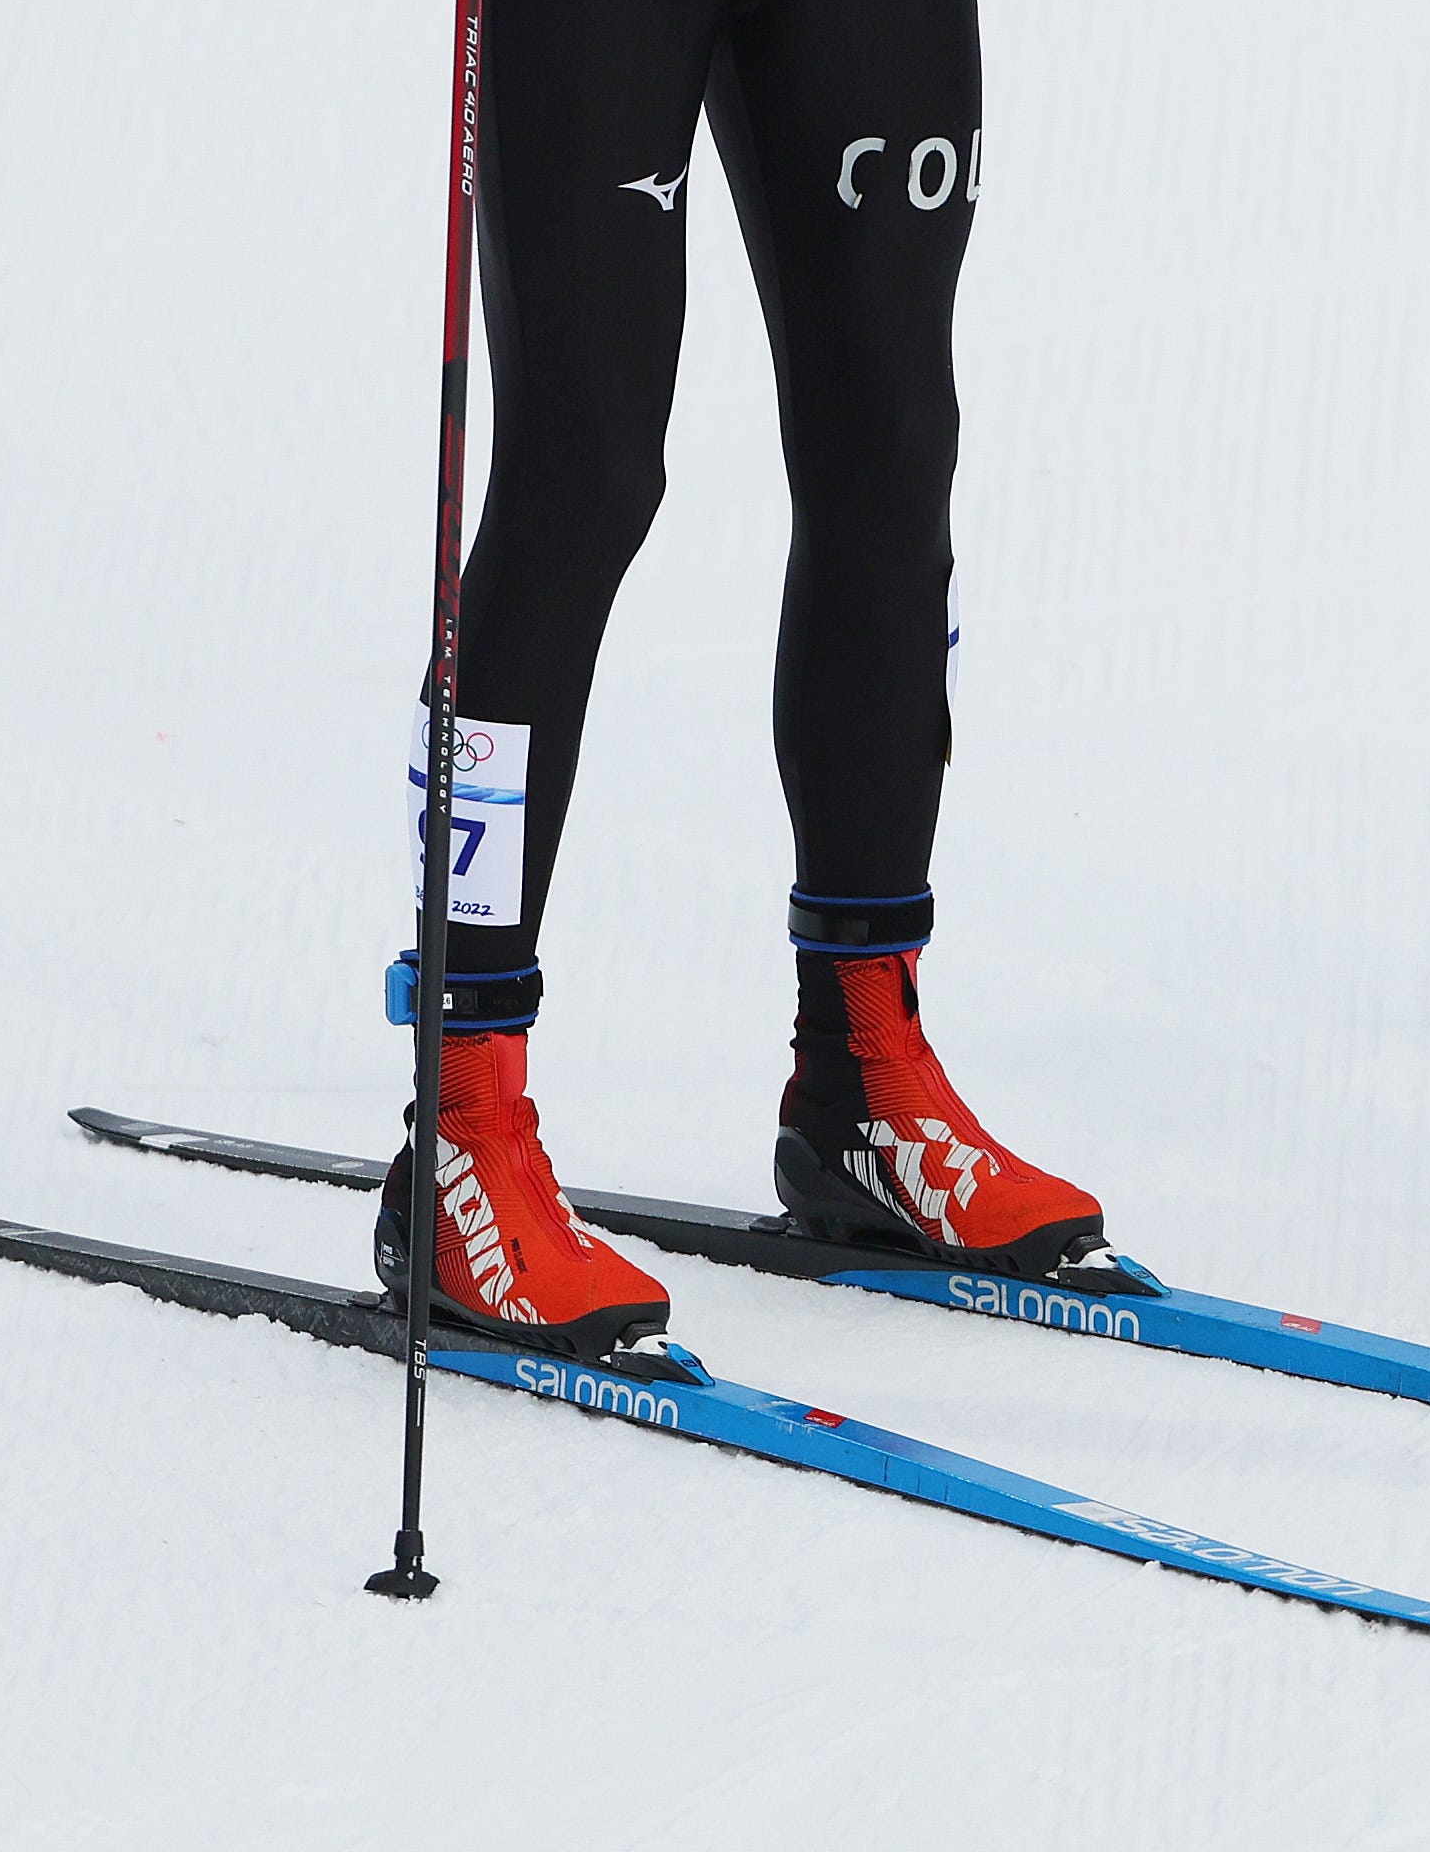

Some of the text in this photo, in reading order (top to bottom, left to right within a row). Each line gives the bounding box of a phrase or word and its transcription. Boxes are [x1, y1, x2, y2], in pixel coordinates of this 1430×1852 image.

[464, 15, 479, 87] TRIAC
[460, 126, 476, 197] AERO
[438, 674, 452, 814] TECHNOLOGY
[451, 900, 496, 916] 2022
[948, 1274, 1141, 1342] salomon
[514, 1358, 680, 1429] salomon
[1112, 1515, 1377, 1597] salomon
